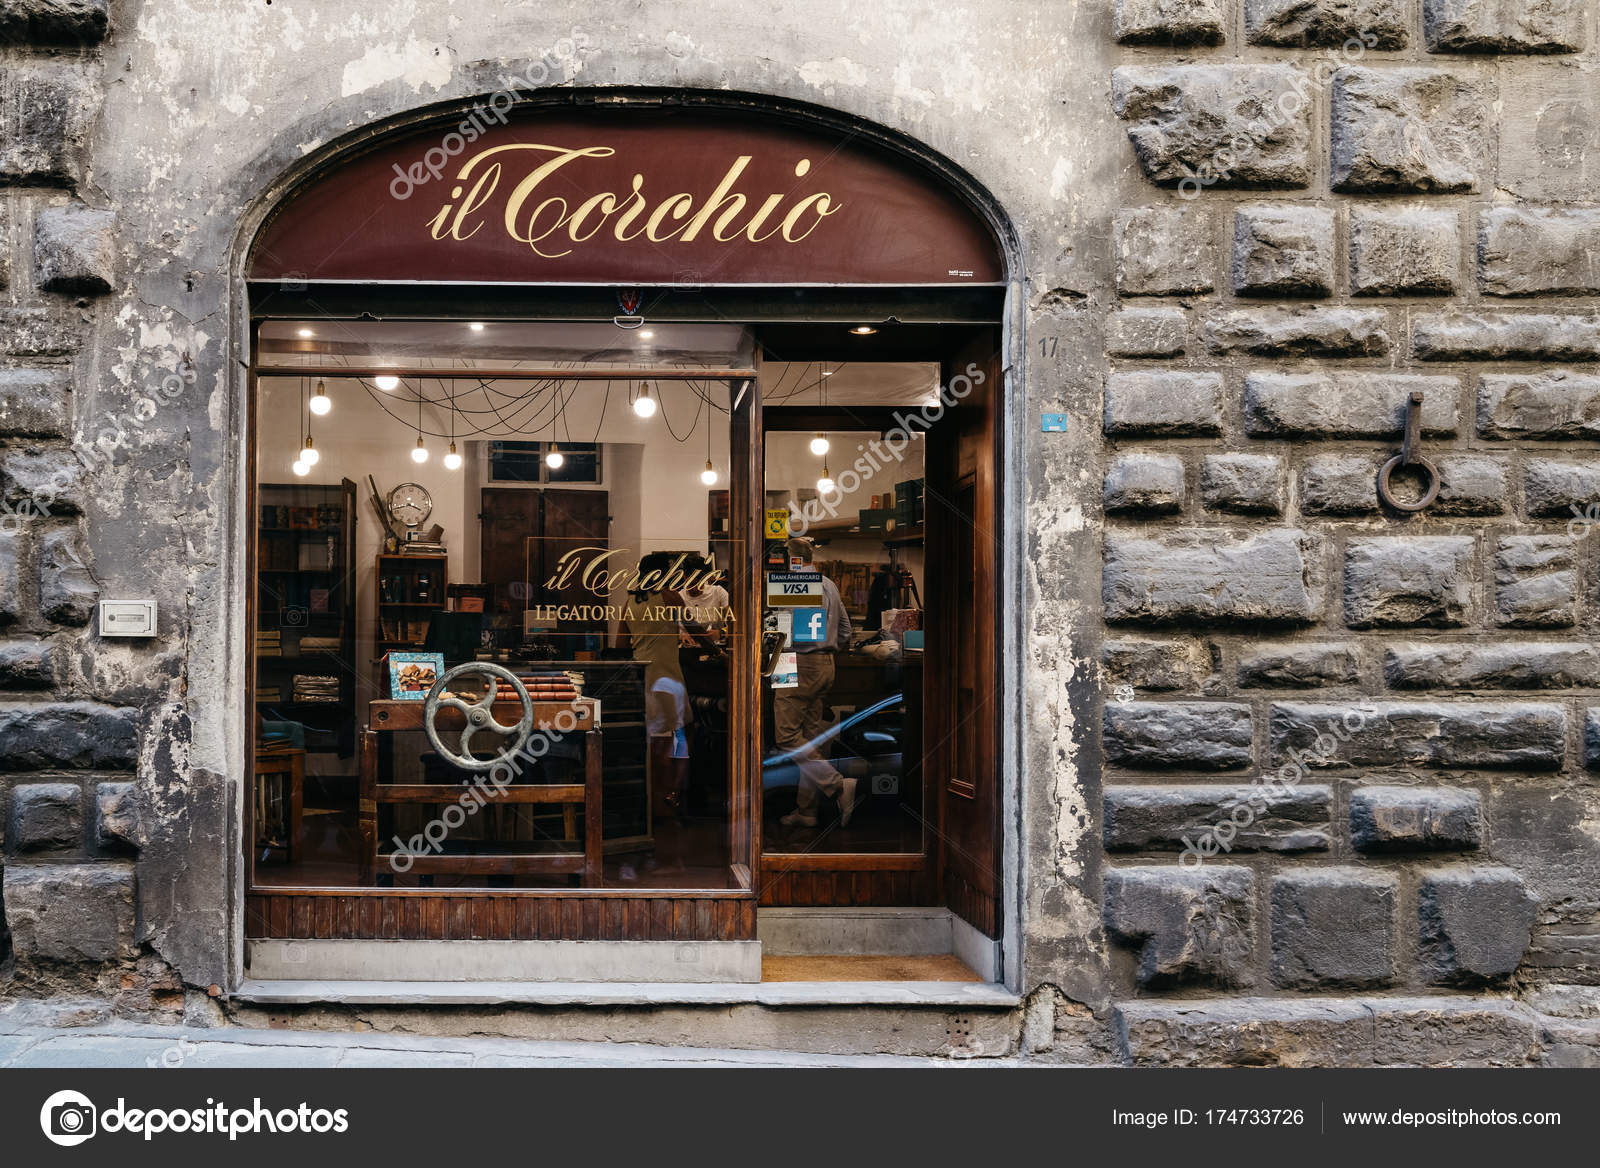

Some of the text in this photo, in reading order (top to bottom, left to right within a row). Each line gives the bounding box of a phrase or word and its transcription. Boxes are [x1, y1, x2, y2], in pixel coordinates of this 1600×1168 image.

[426, 163, 501, 240] il
[1039, 336, 1058, 358] 17
[543, 557, 581, 591] il
[784, 584, 808, 593] VISA
[535, 605, 736, 622] LEGATORIA ARTIGIANA
